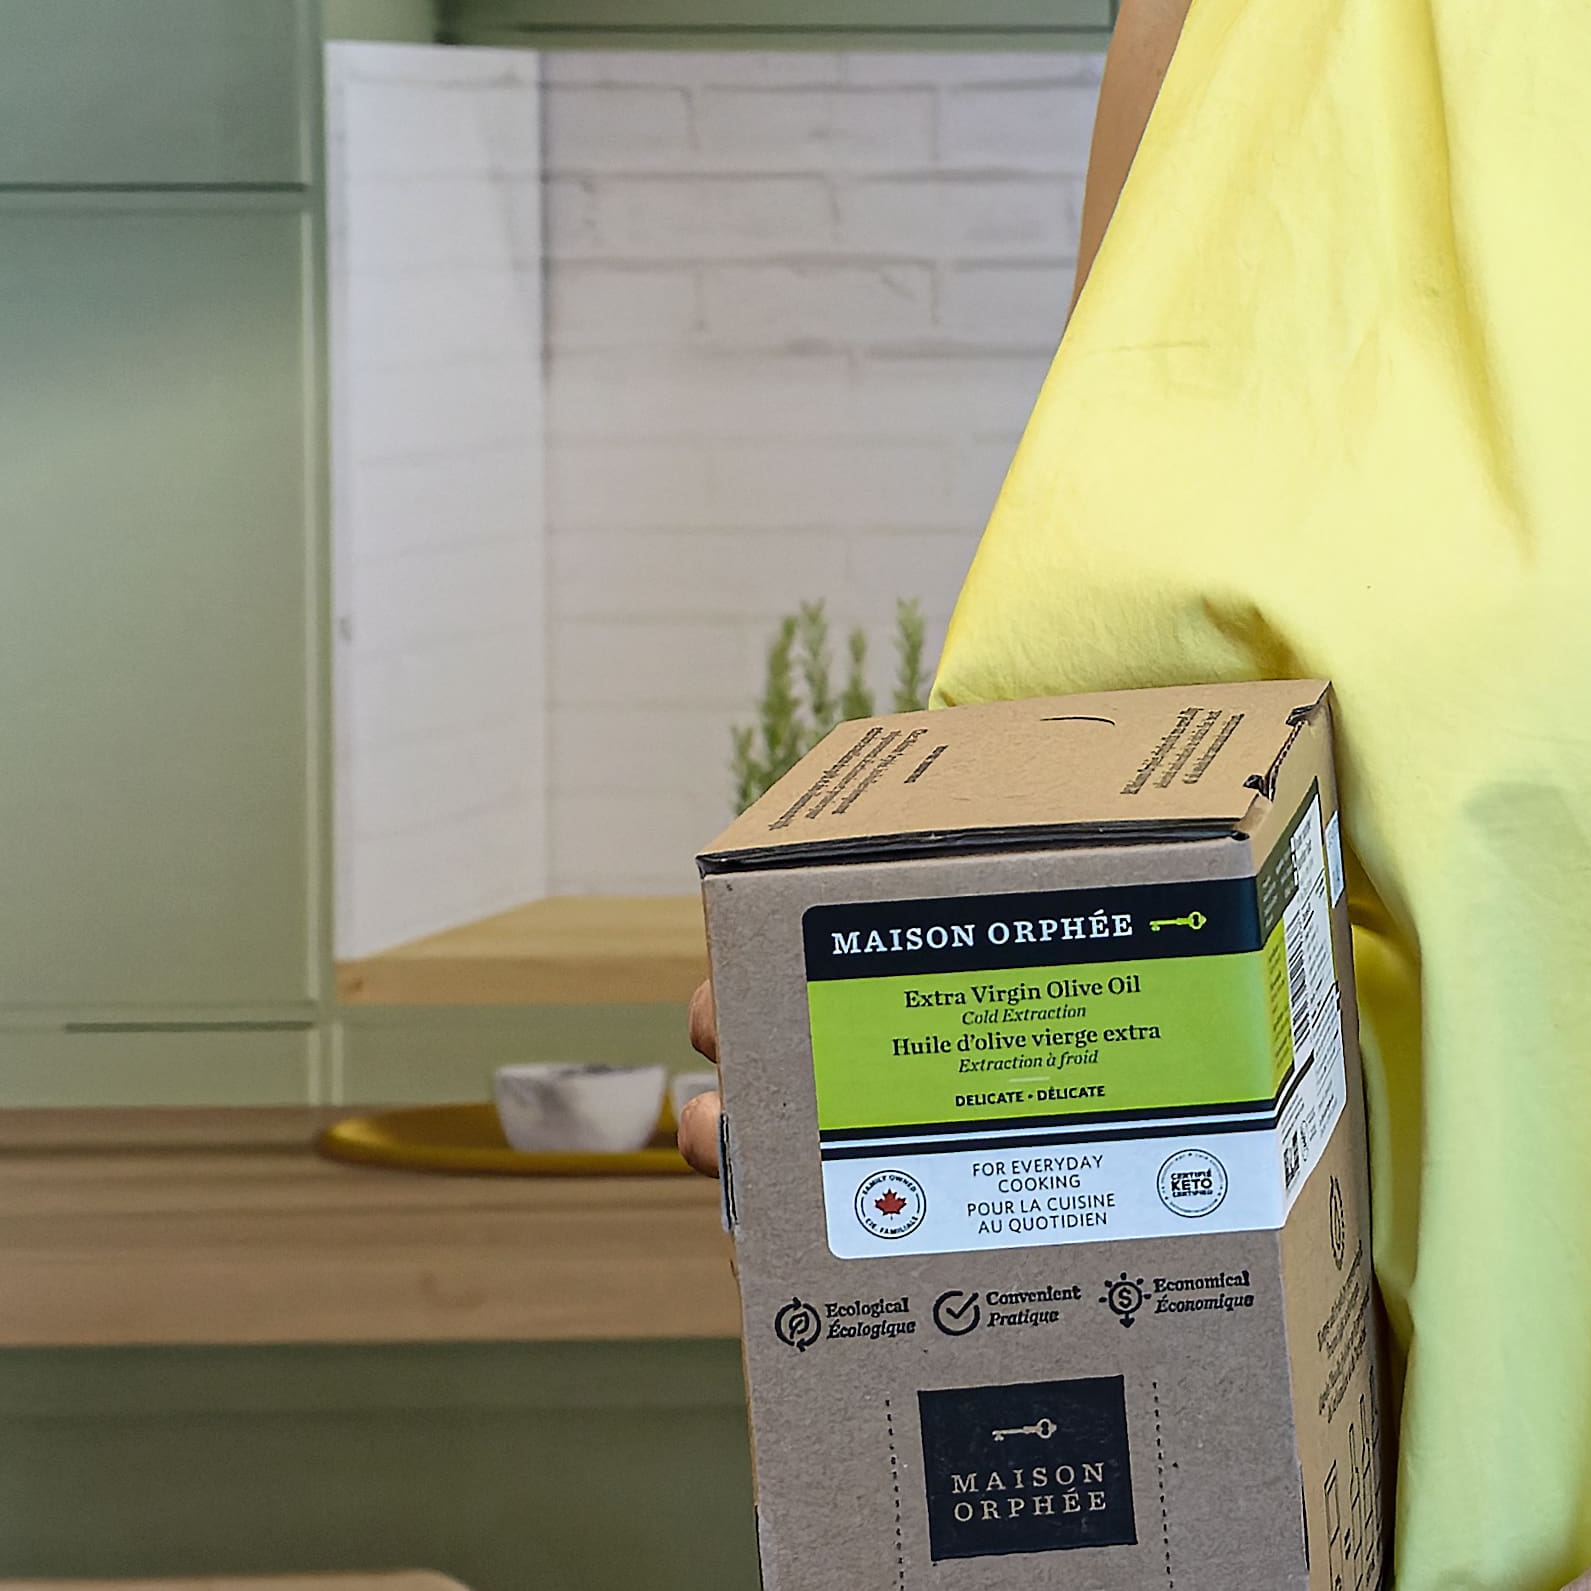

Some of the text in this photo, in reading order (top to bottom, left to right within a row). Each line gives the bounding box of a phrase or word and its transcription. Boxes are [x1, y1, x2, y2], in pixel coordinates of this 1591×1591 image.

[832, 909, 1133, 955] MAISON ORPHÉE
[904, 975, 1141, 1008] Extra Virgin Olive Oil
[962, 1004, 1087, 1026] Cold Extraction
[892, 1024, 1161, 1057] Huile d'olive vierge extra
[958, 1050, 1099, 1073] Extraction à froid
[955, 1085, 1105, 1107] DELICATE DÉLICATE
[972, 1155, 1104, 1177] FOR EVERYDAY
[888, 1174, 917, 1193] OWNED
[998, 1174, 1081, 1194] COOKING
[1171, 1178, 1213, 1192] KETO
[967, 1193, 1116, 1217] POUR LA CUISINE
[978, 1213, 1108, 1234] AU QUOTIDIEN
[1153, 1270, 1251, 1293] Economical
[986, 1285, 1082, 1306] Convenient
[1154, 1293, 1255, 1314] Économique
[824, 1297, 910, 1318] Ecological
[986, 1309, 1060, 1327] Pratique
[826, 1319, 917, 1340] Écologique
[951, 1462, 1105, 1494] MAISON
[954, 1487, 1107, 1522] ORPHÉE
